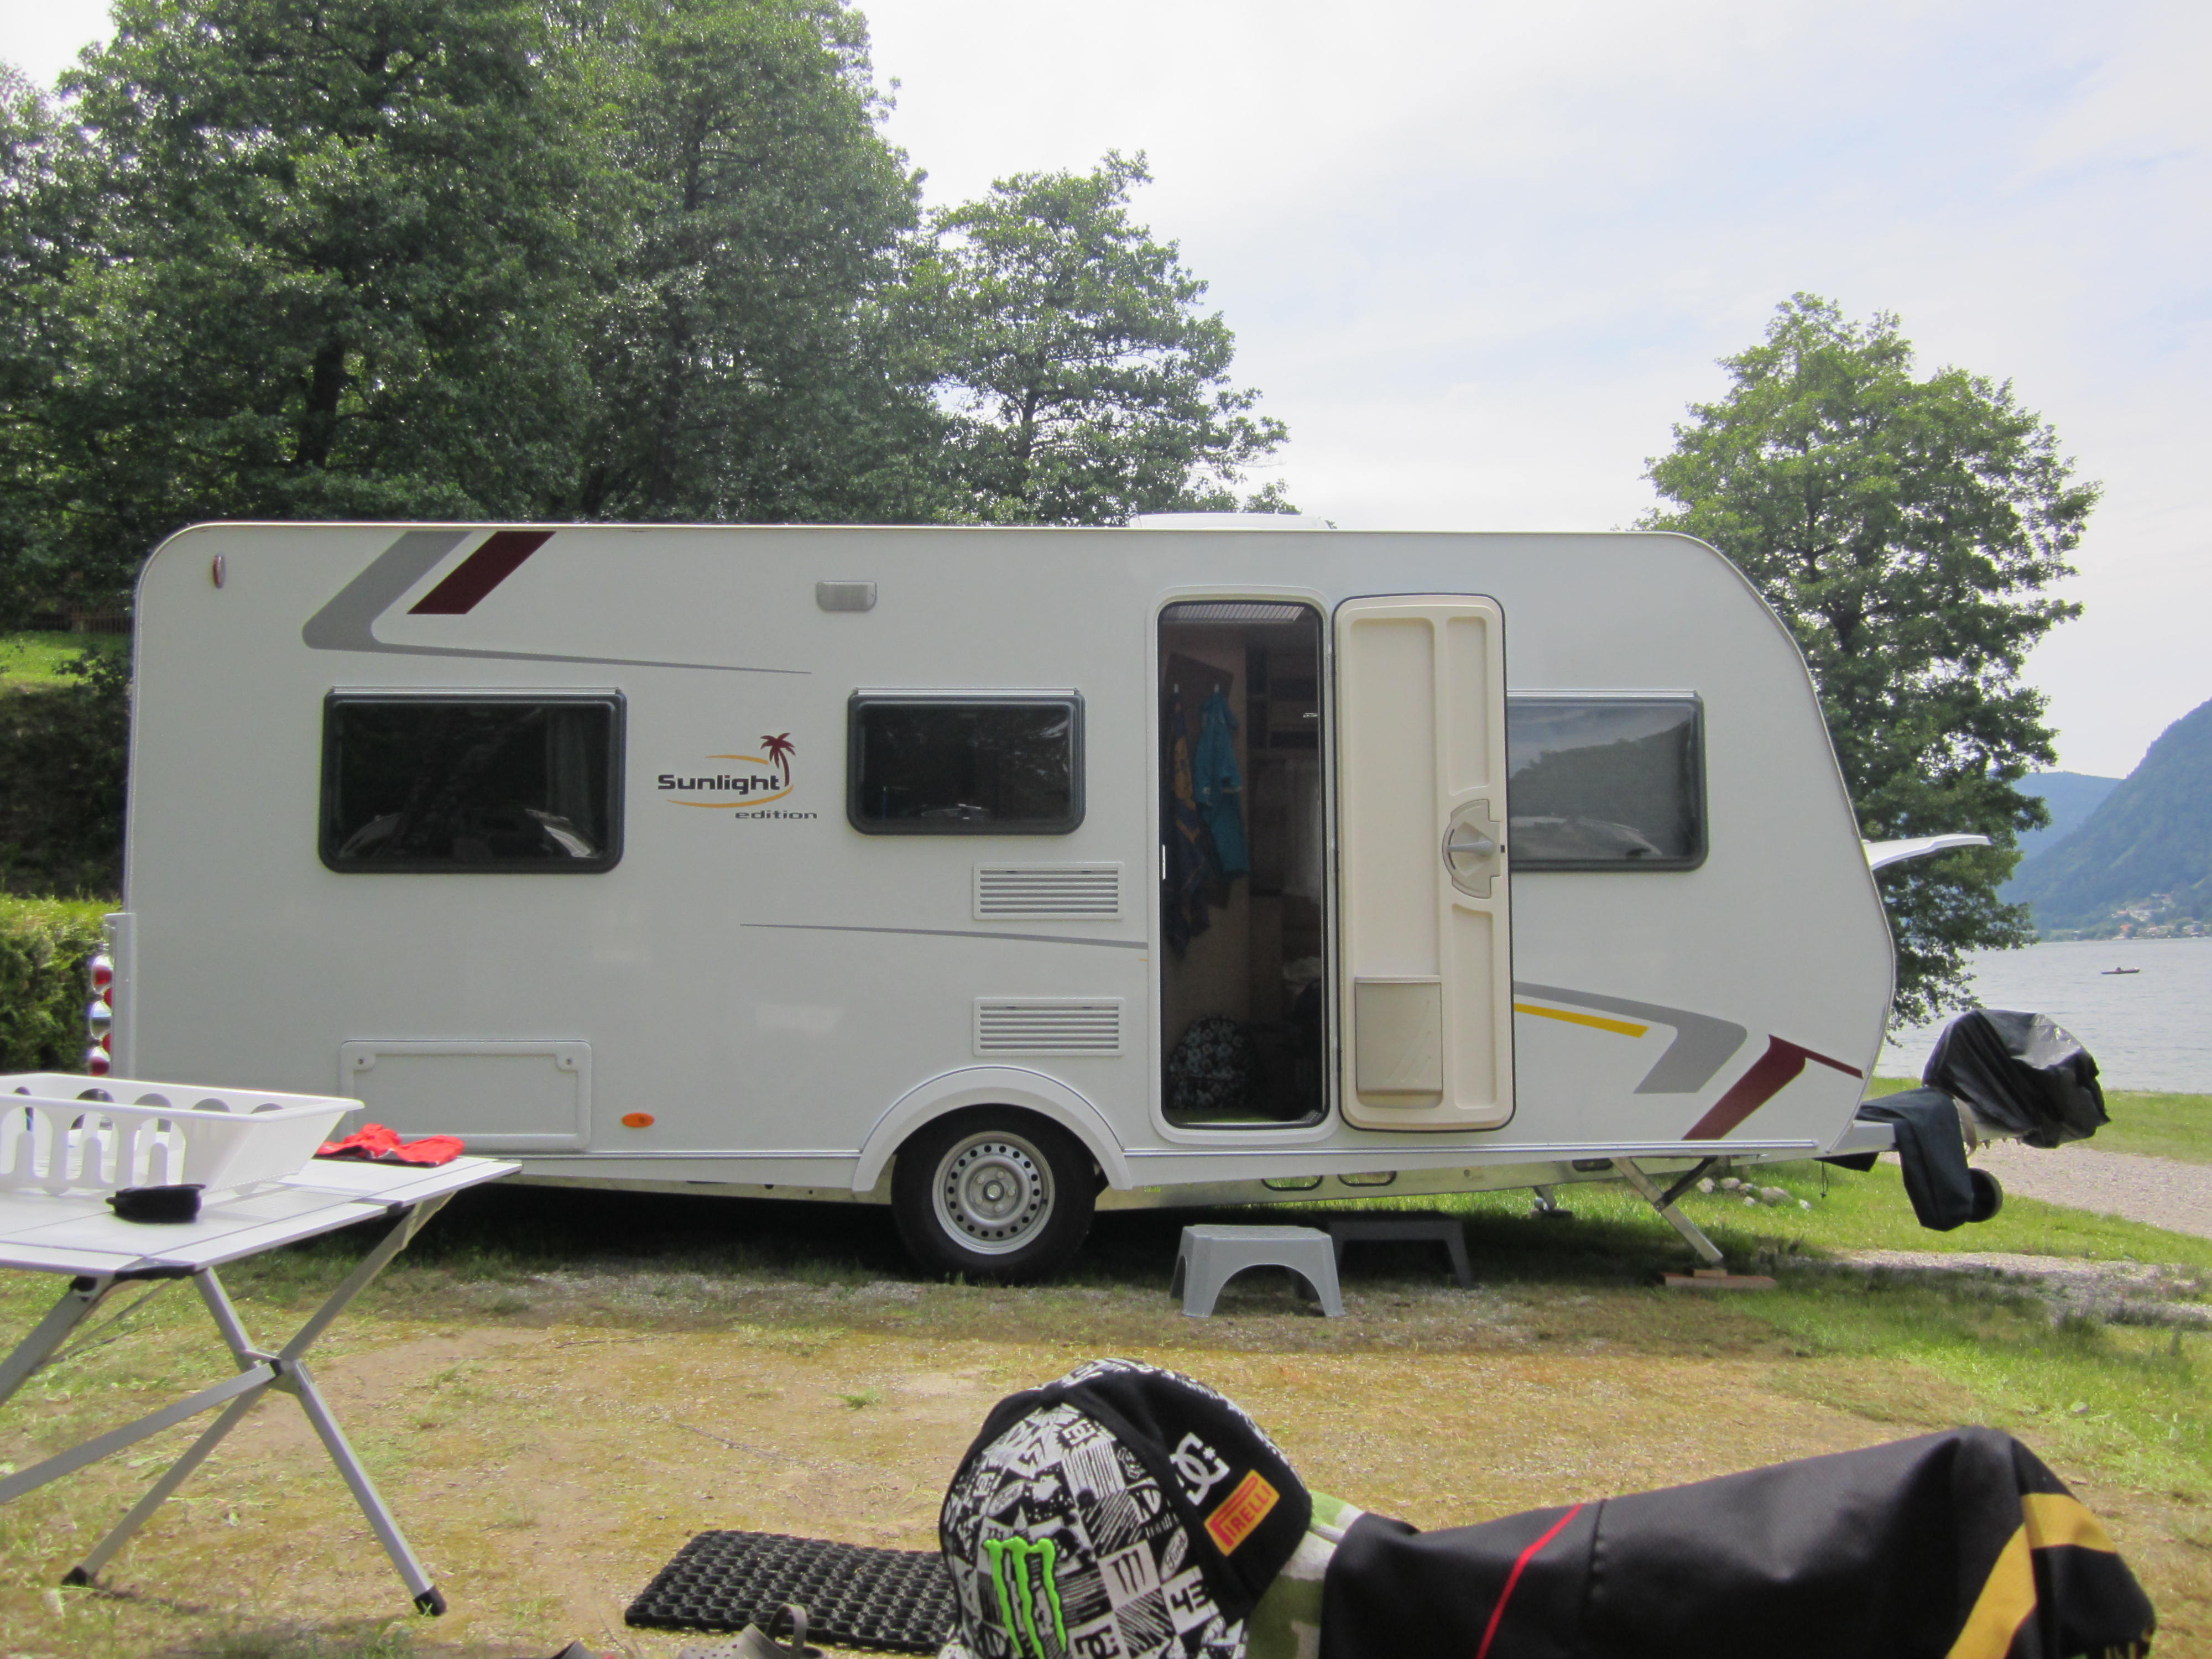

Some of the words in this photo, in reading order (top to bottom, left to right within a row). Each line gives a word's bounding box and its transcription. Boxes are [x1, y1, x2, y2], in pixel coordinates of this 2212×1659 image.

[658, 774, 780, 795] Sunlight
[735, 810, 817, 819] edition
[1208, 1476, 1272, 1547] PIRELLI
